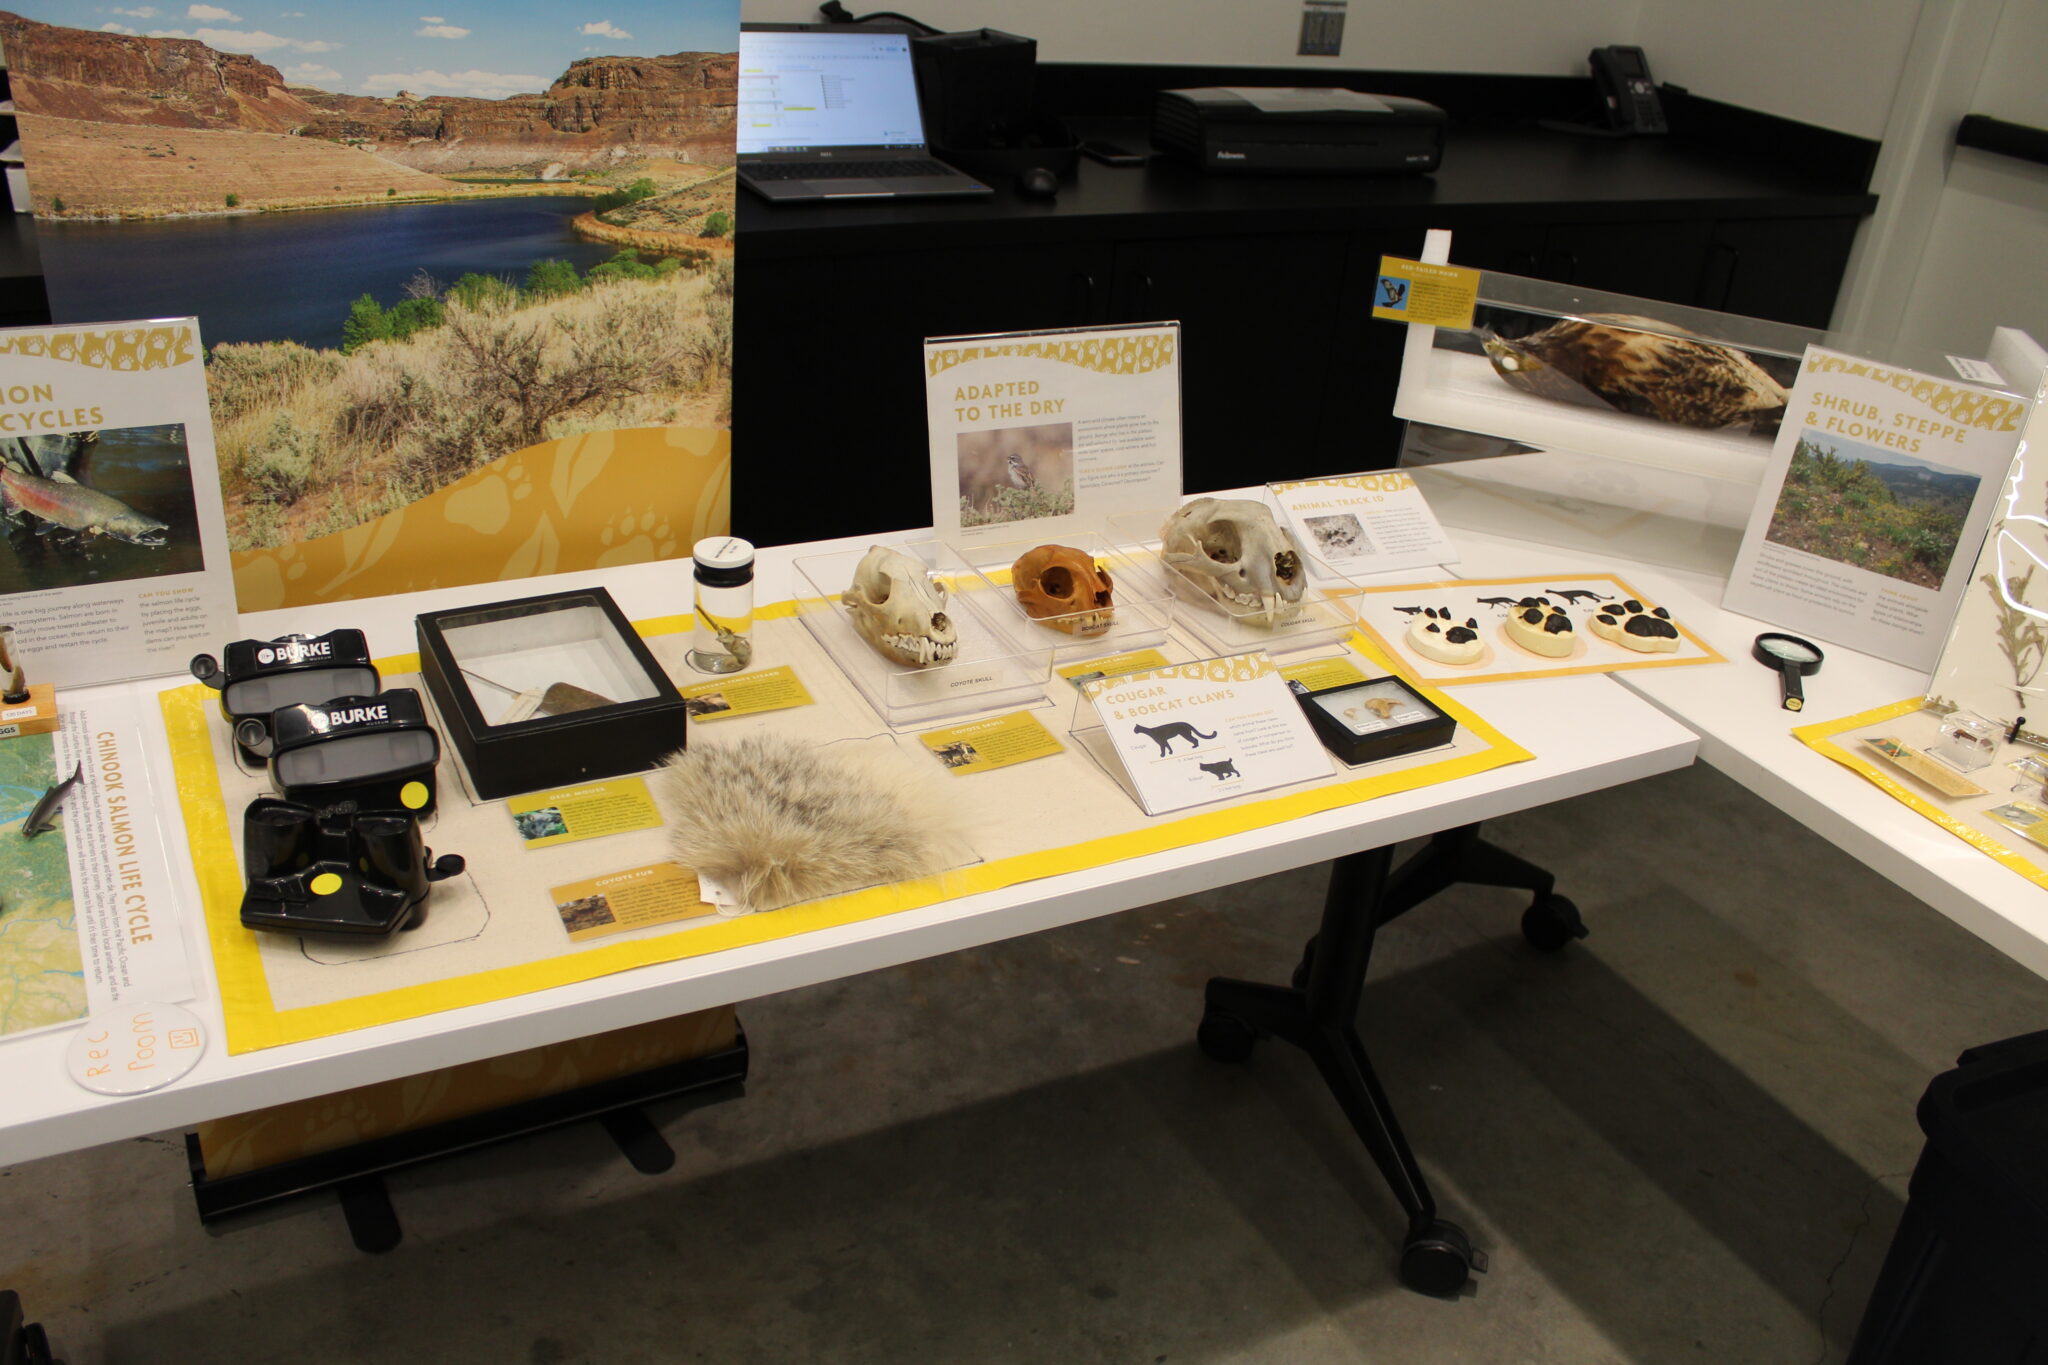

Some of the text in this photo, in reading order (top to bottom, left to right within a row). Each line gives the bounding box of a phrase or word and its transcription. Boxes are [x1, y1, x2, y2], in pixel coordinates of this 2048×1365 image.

[0, 384, 53, 405] ON
[955, 380, 1040, 401] ADAPTED
[0, 407, 104, 432] CYCLES
[956, 398, 1065, 422] TO THE DRY
[1811, 391, 1968, 444] SHRUB, STEPPE
[1805, 411, 1921, 453] & FLOWERS
[1292, 502, 1334, 511] ANIMAL
[1336, 496, 1370, 506] TRACK
[276, 642, 330, 661] BURKE
[950, 679, 974, 687] COYOTE
[1106, 686, 1167, 705] COUGAR
[1114, 689, 1235, 720] & BOBCAT CLAWS
[330, 705, 388, 726] BURKE
[952, 720, 1005, 735] COYOTE SKULL
[574, 787, 605, 796] MOUSE
[96, 732, 152, 944] CHINOOK SALMON LIFE CYCLE
[596, 870, 654, 886] COYOTE FUR
[116, 938, 126, 955] Pacific
[118, 955, 129, 974] Ocean
[122, 976, 131, 986] and
